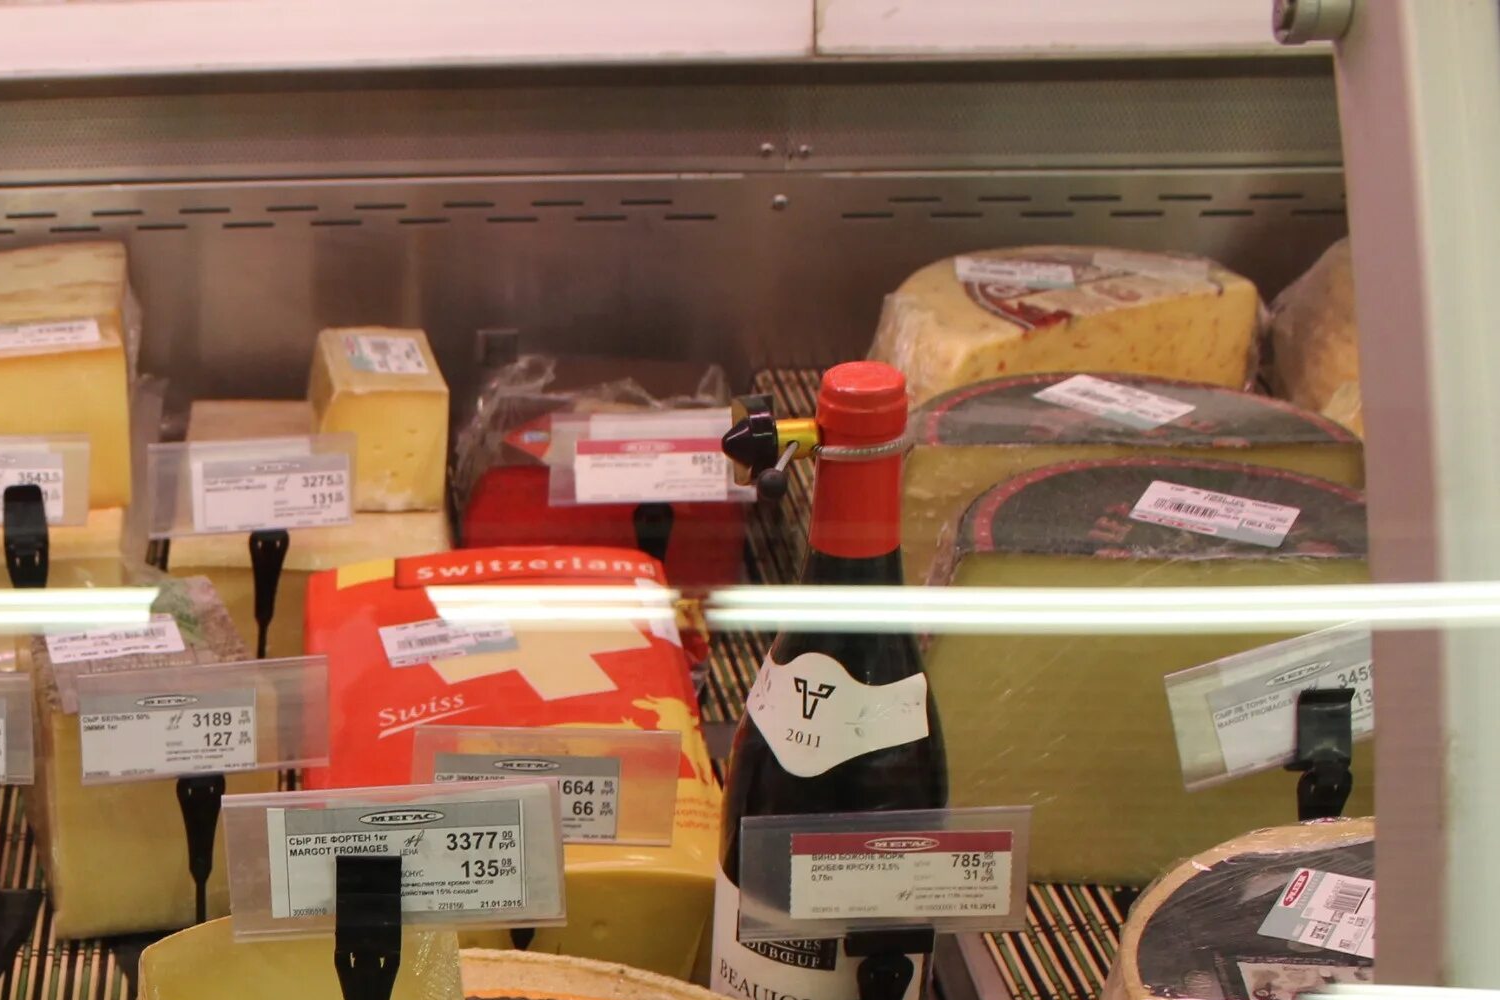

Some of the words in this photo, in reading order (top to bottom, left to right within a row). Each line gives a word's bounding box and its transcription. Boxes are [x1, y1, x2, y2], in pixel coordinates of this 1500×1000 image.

[378, 693, 465, 727] Swiss
[193, 712, 232, 728] 3189
[203, 732, 233, 747] 127
[786, 728, 822, 749] 2011
[573, 801, 593, 815] 66
[370, 812, 437, 823] МЕГАС
[289, 837, 312, 846] СЫР
[314, 836, 327, 845] ЛЕ
[329, 834, 371, 844] ФОРТЕН
[374, 834, 388, 842] 1кг
[446, 832, 498, 851] 3377
[499, 838, 516, 850] руб
[875, 840, 932, 848] МЕГАС
[289, 846, 332, 857] MARGOT
[334, 844, 388, 854] FROMAGES
[812, 853, 837, 861] ВИНО
[951, 854, 981, 867] 785
[461, 860, 498, 878] 135
[500, 865, 516, 877] руб
[963, 870, 978, 881] 31
